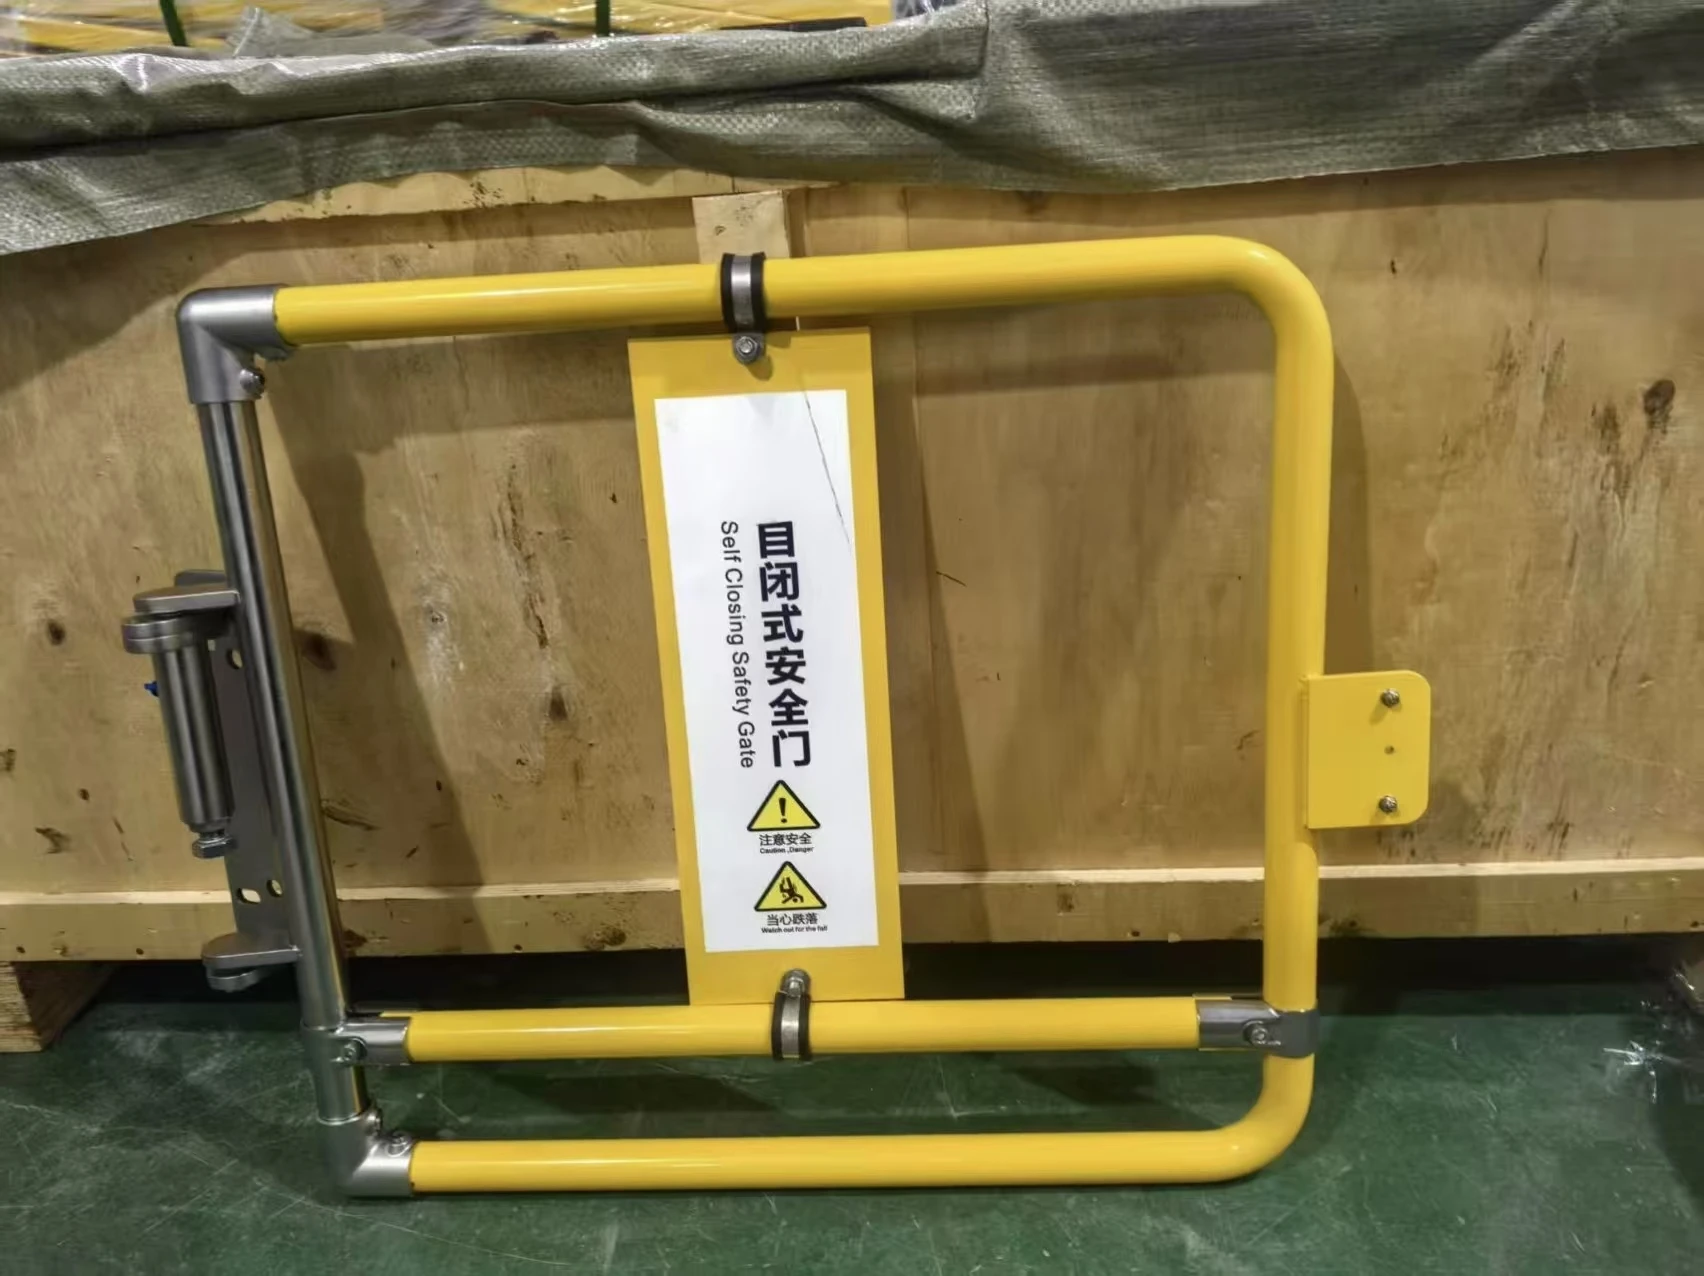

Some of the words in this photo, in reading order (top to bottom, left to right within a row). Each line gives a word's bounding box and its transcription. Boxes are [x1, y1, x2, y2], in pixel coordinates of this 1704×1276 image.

[720, 520, 742, 562] Self
[725, 568, 747, 646] Closing
[731, 651, 752, 716] Safety
[737, 721, 756, 769] Gate
[759, 832, 812, 846] 注意安全
[767, 912, 818, 926] 当心跌落
